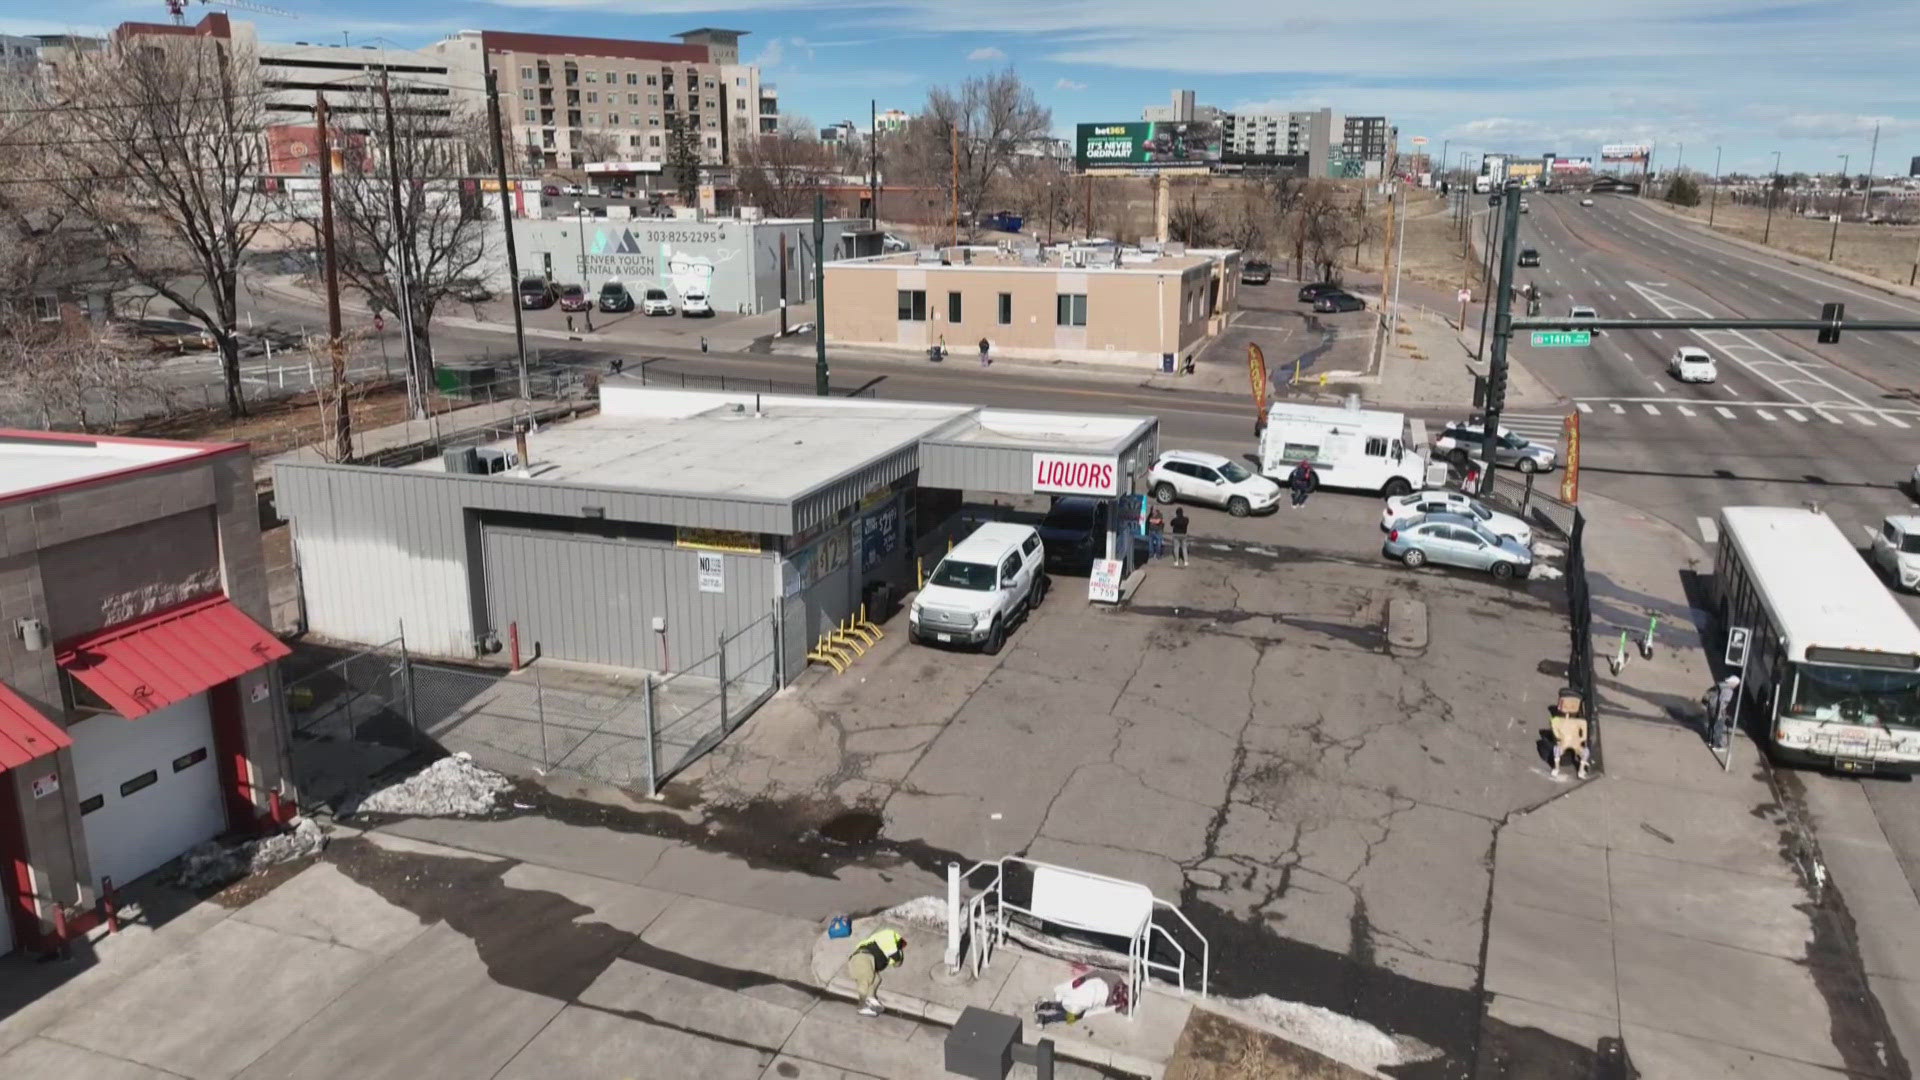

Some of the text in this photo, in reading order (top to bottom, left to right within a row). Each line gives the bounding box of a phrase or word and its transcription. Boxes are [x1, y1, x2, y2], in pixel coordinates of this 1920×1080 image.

[1095, 127, 1125, 135] bet365
[1087, 141, 1132, 150] IT'S NEVER
[1086, 149, 1132, 158] ORDINARY
[576, 255, 654, 266] DENVER YOUTH
[577, 265, 655, 276] DENTAL & VISION
[1037, 460, 1113, 489] LIQUORS
[700, 556, 710, 572] NO
